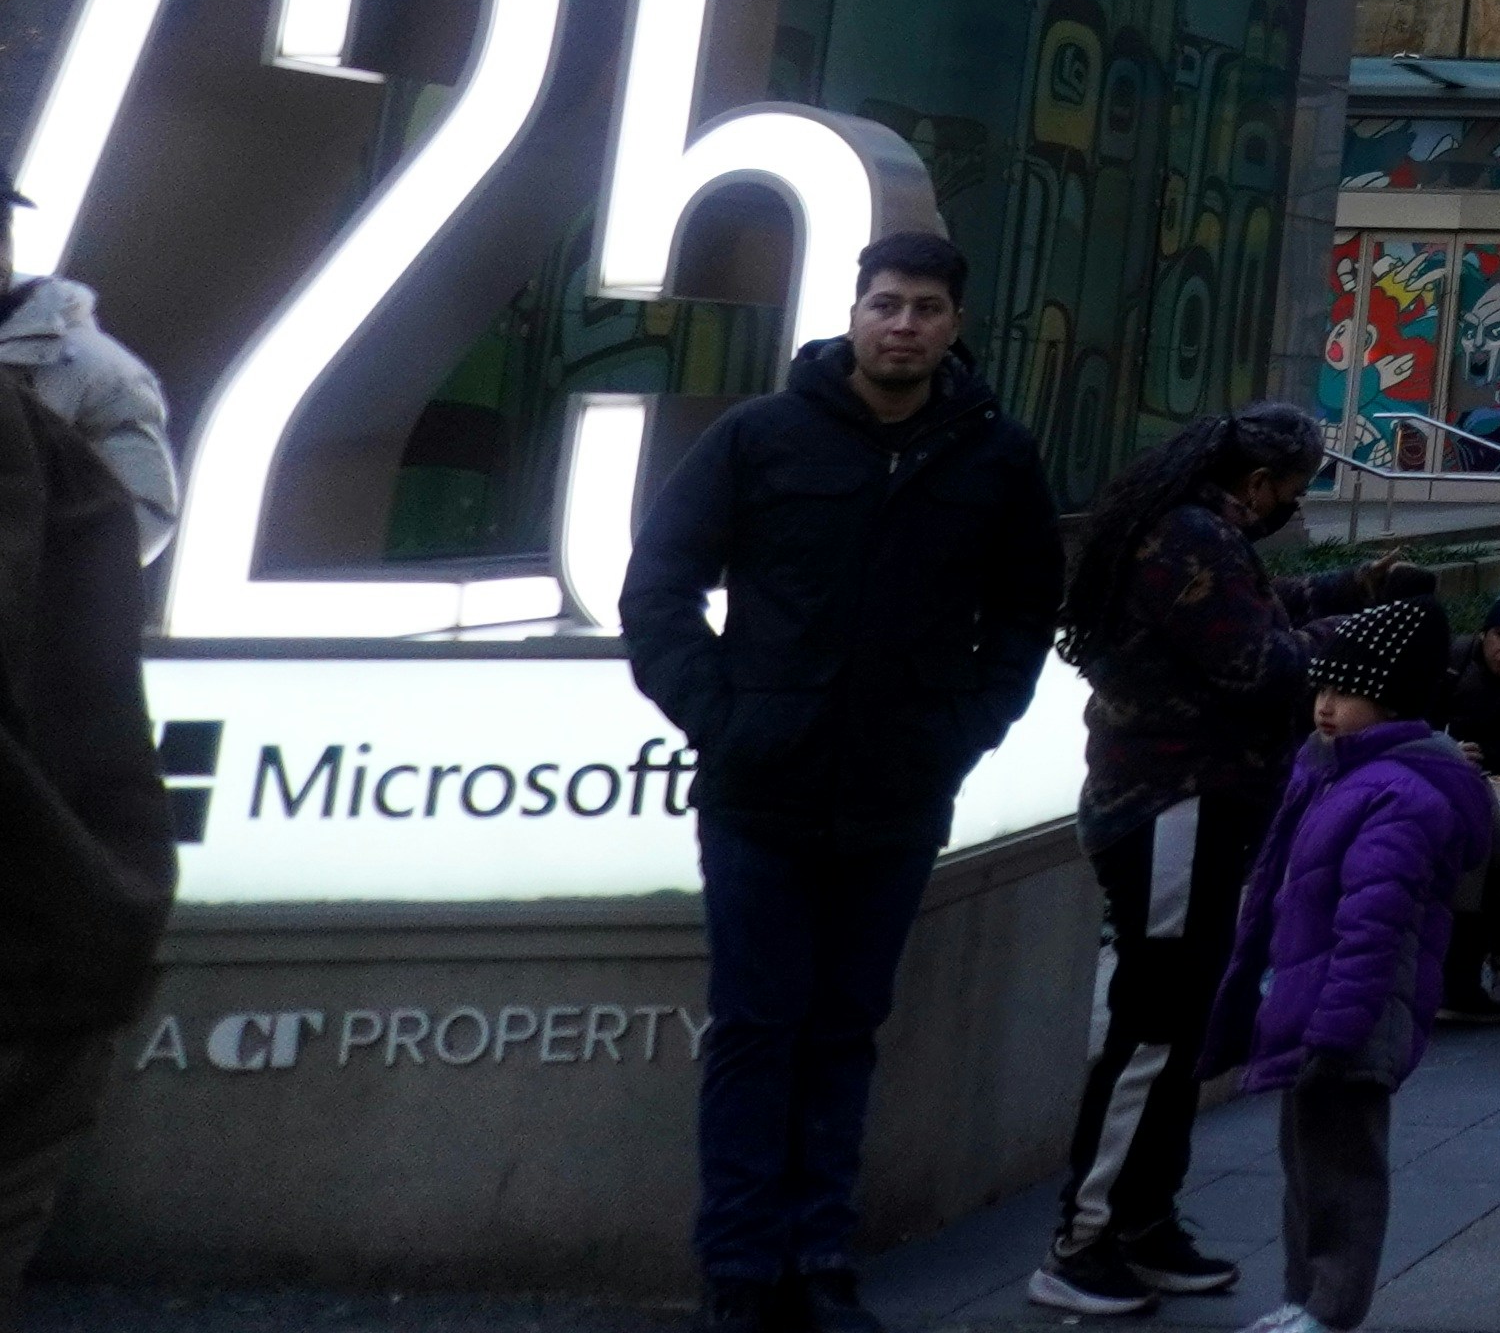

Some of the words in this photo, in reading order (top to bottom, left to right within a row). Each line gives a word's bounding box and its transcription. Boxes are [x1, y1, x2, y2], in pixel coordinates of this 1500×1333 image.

[248, 737, 699, 821] Microsoft
[134, 1015, 189, 1071] A
[338, 1003, 713, 1068] PROPERTY
